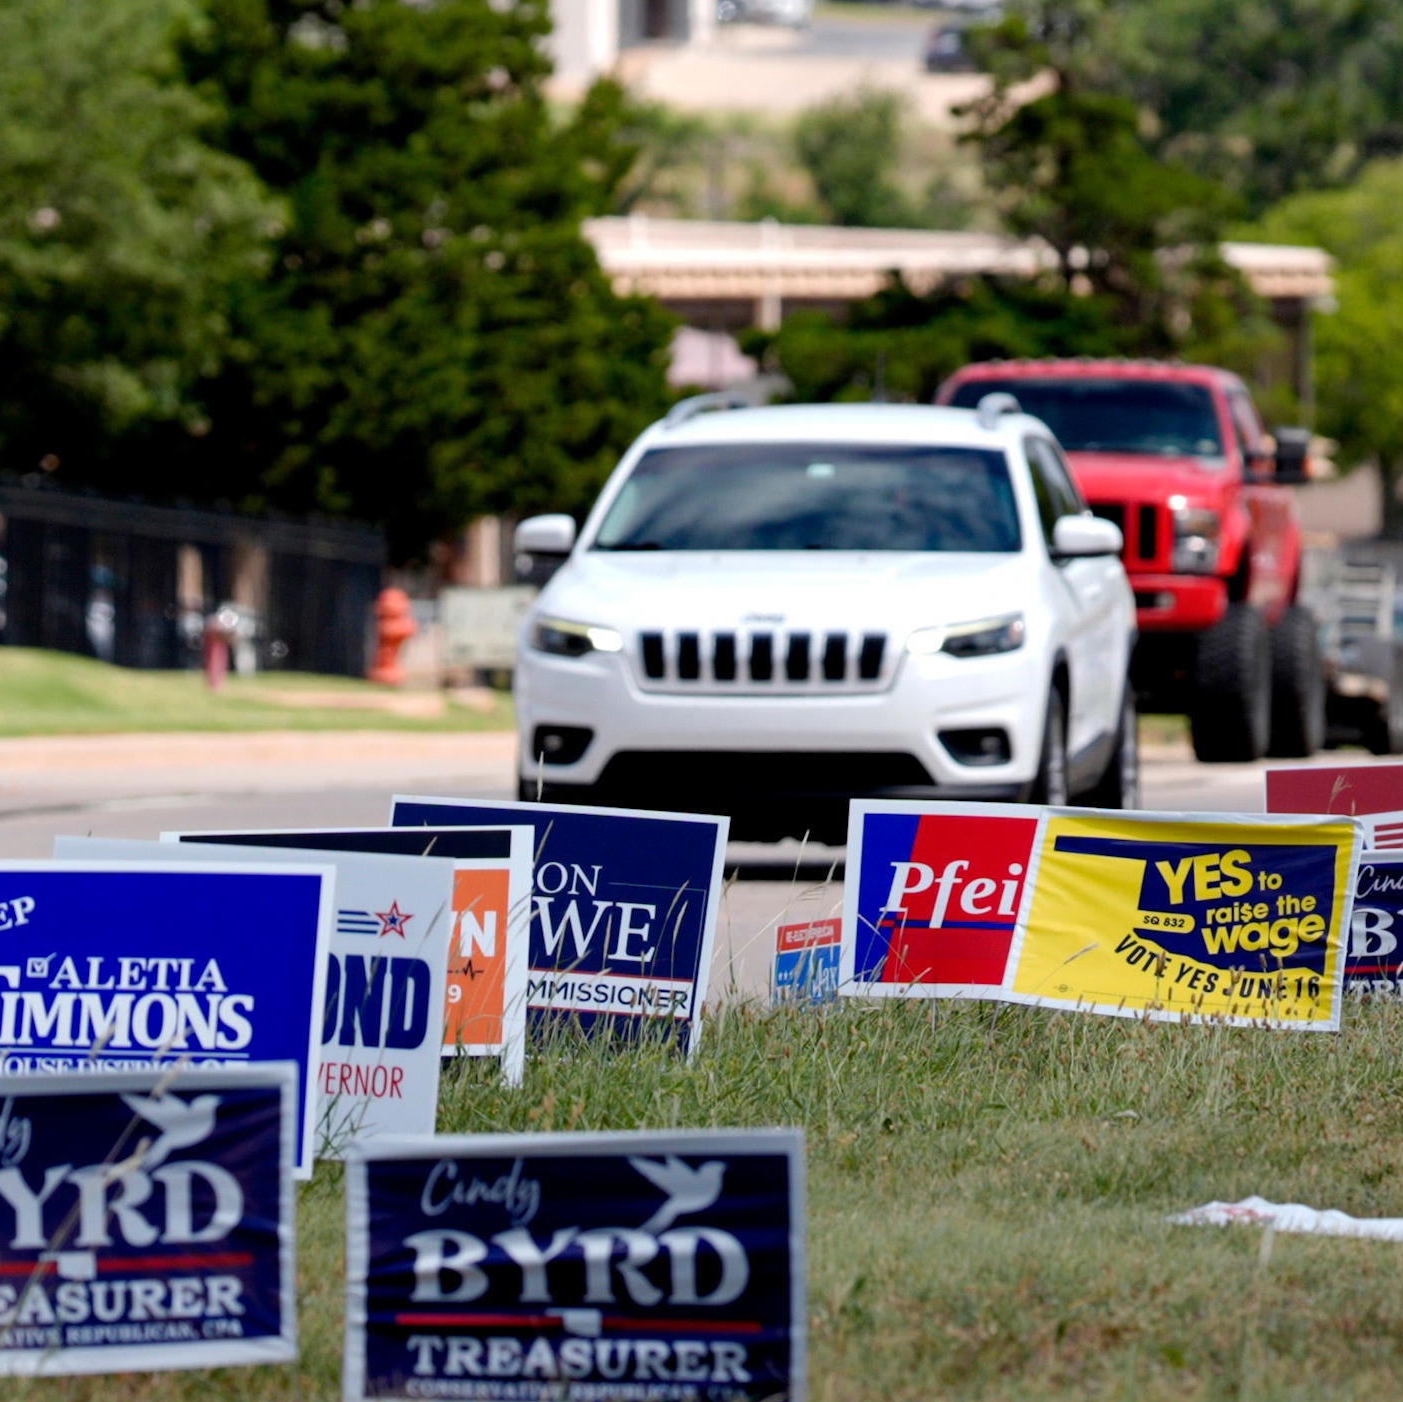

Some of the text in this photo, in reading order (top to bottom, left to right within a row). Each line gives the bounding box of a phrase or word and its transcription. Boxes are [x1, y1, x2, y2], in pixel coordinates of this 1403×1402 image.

[532, 861, 603, 897] ON
[880, 859, 1023, 928] Pfei
[1155, 849, 1283, 905] YES to
[1143, 914, 1186, 928] SQ 832
[1276, 894, 1317, 917] the
[450, 910, 497, 957] N
[533, 896, 657, 963] WE
[1201, 913, 1326, 958] wage
[49, 956, 228, 992] ALETIA
[1114, 934, 1172, 978] VOTE
[1174, 963, 1219, 993] YES
[1294, 975, 1321, 1000] 16
[76, 1058, 186, 1074] DISTRI
[318, 1062, 404, 1098] ERNOR
[421, 1158, 540, 1227] Cindy
[403, 1226, 750, 1307] BYRD
[406, 1335, 751, 1382] TREASURER
